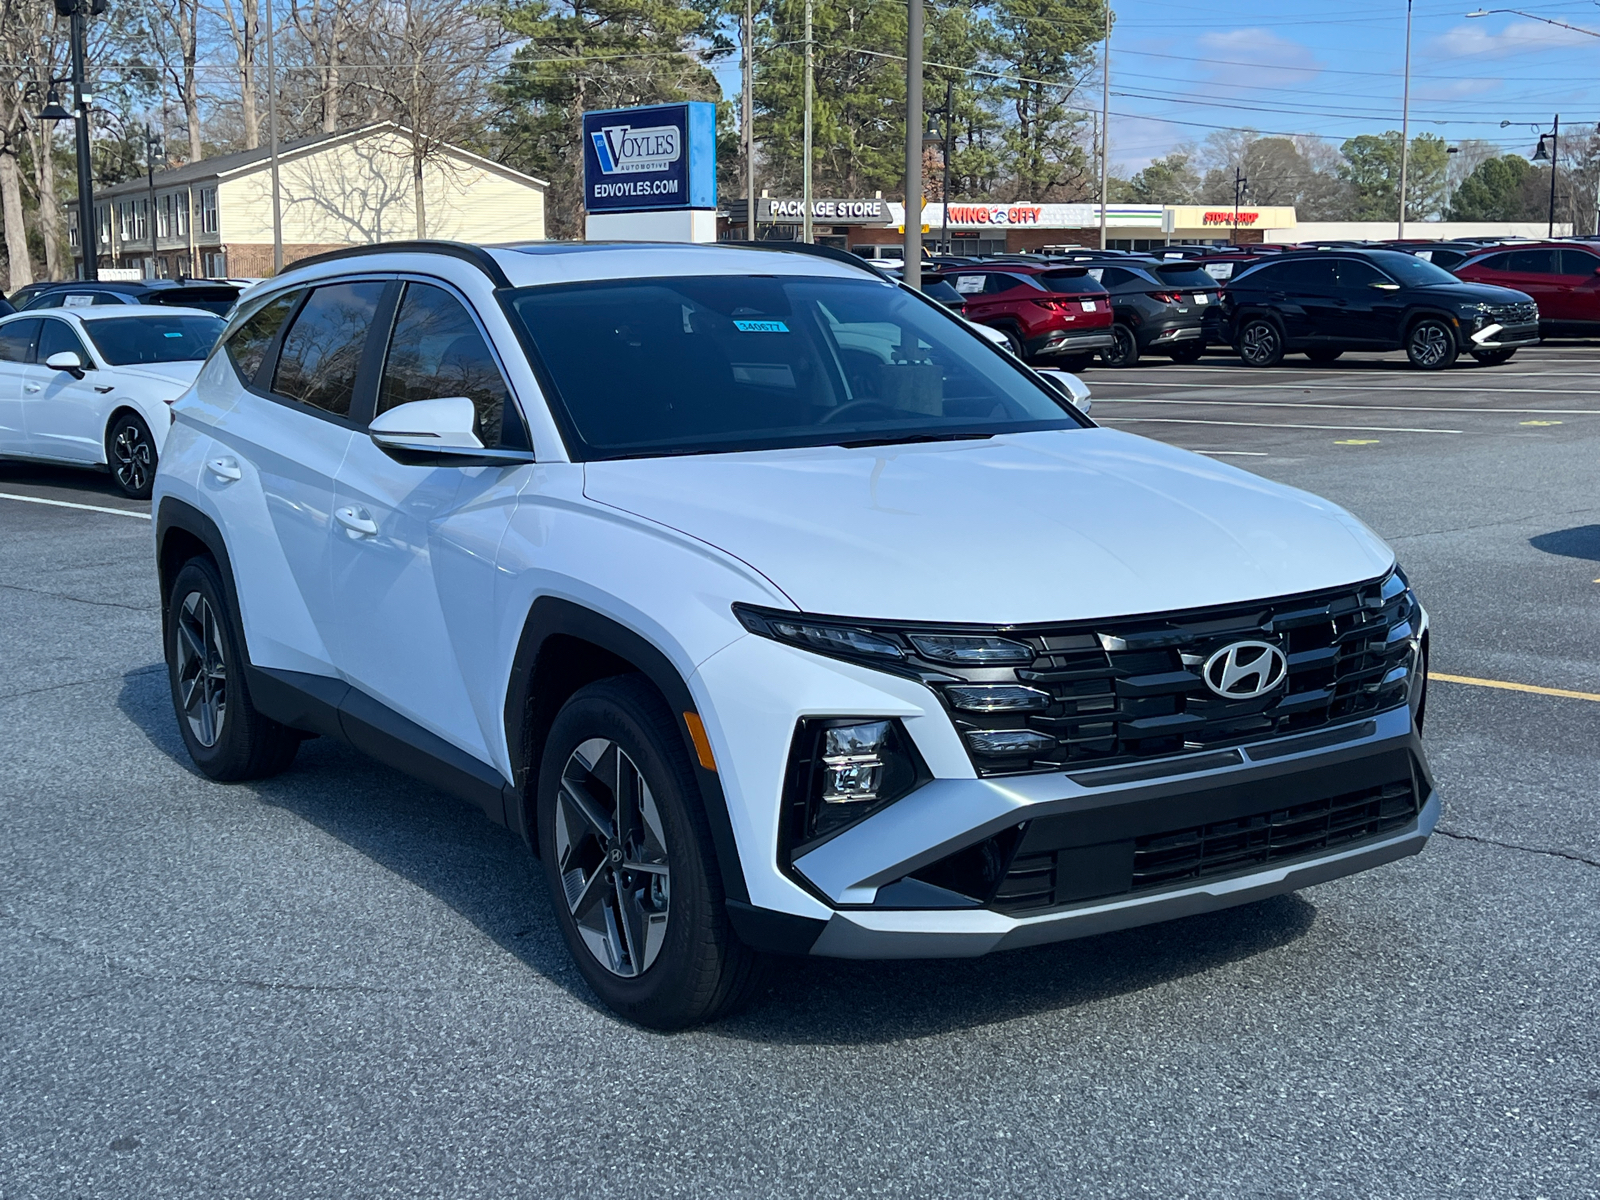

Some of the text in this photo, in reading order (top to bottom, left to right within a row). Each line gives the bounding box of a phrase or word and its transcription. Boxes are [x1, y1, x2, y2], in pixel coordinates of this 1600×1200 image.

[604, 128, 674, 168] VOYLES
[620, 162, 668, 171] AUTOMOTIVE
[594, 179, 678, 198] EDVOYLES.COM
[837, 201, 881, 216] STORE
[947, 207, 1042, 223] WING CITY
[1205, 212, 1228, 222] STOP
[1236, 212, 1259, 223] SHOP
[739, 322, 781, 331] 340677
